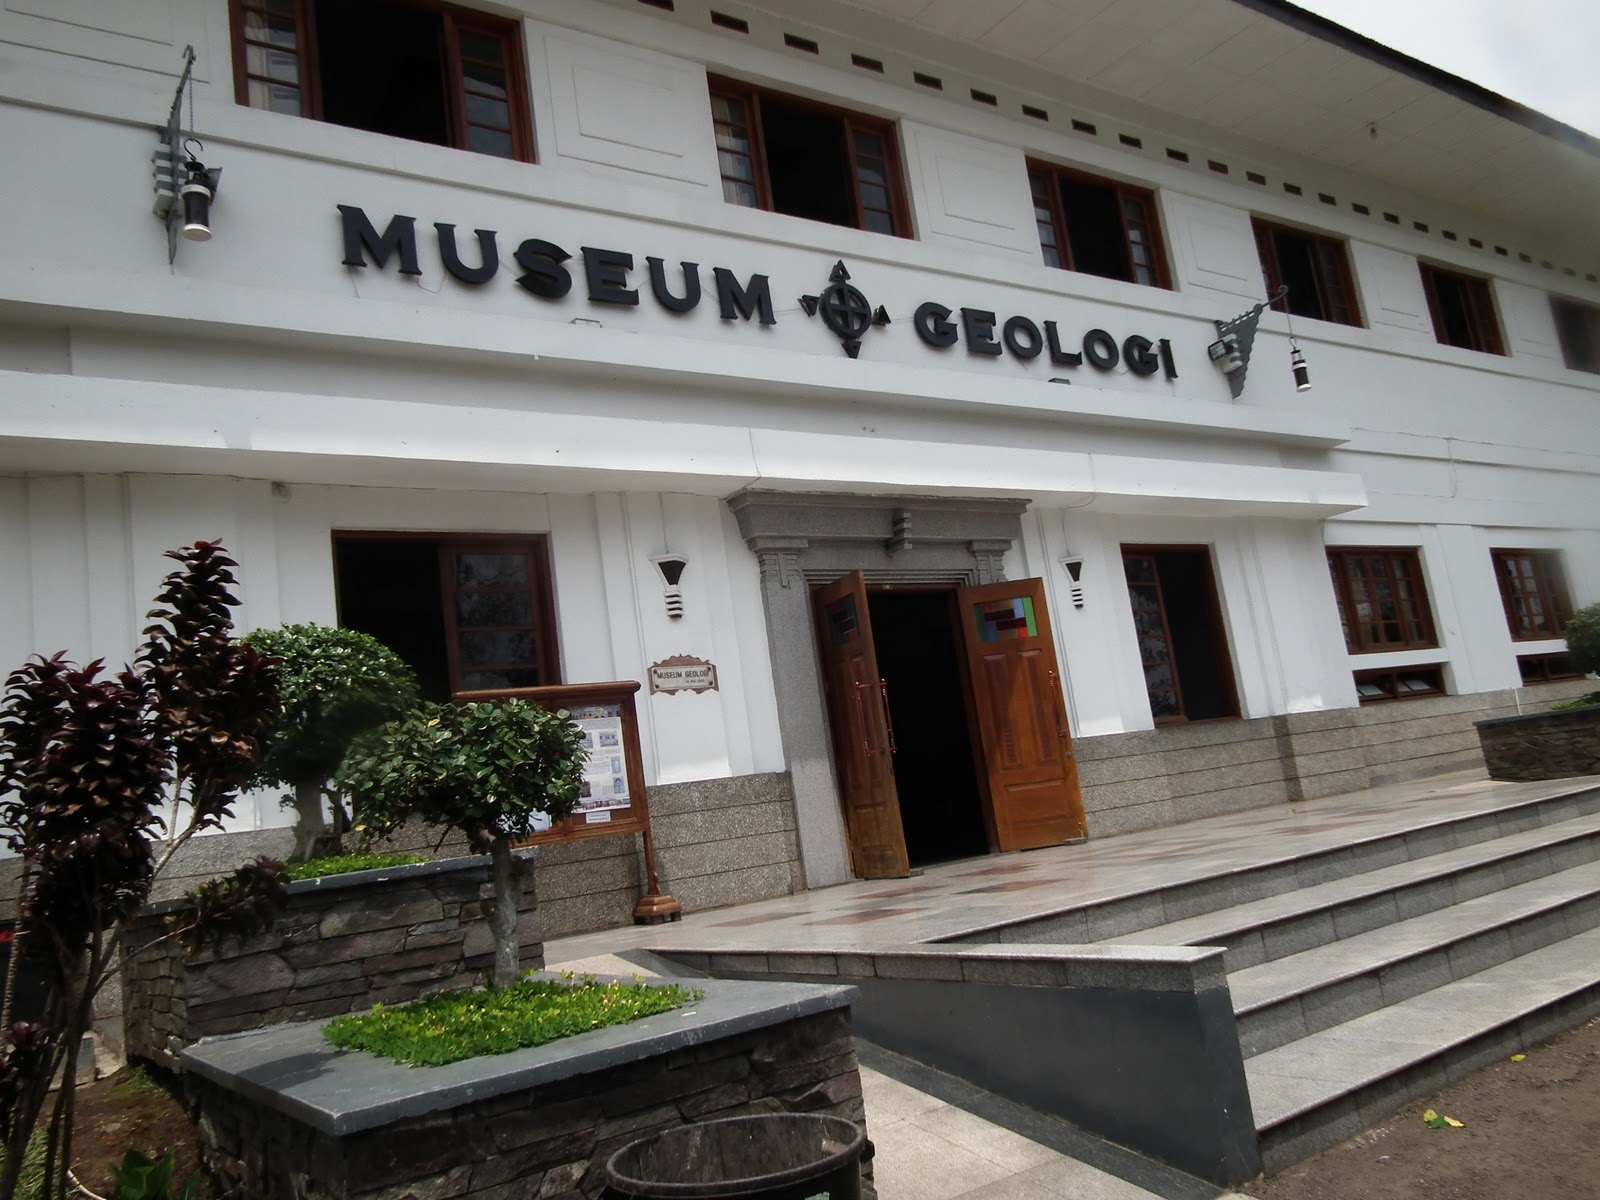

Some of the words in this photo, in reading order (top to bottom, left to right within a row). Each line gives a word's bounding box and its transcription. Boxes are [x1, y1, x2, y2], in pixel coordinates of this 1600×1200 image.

[337, 204, 777, 325] MUSEUM
[914, 301, 1178, 378] GEOLOGI
[685, 670, 709, 678] GEOLOGI
